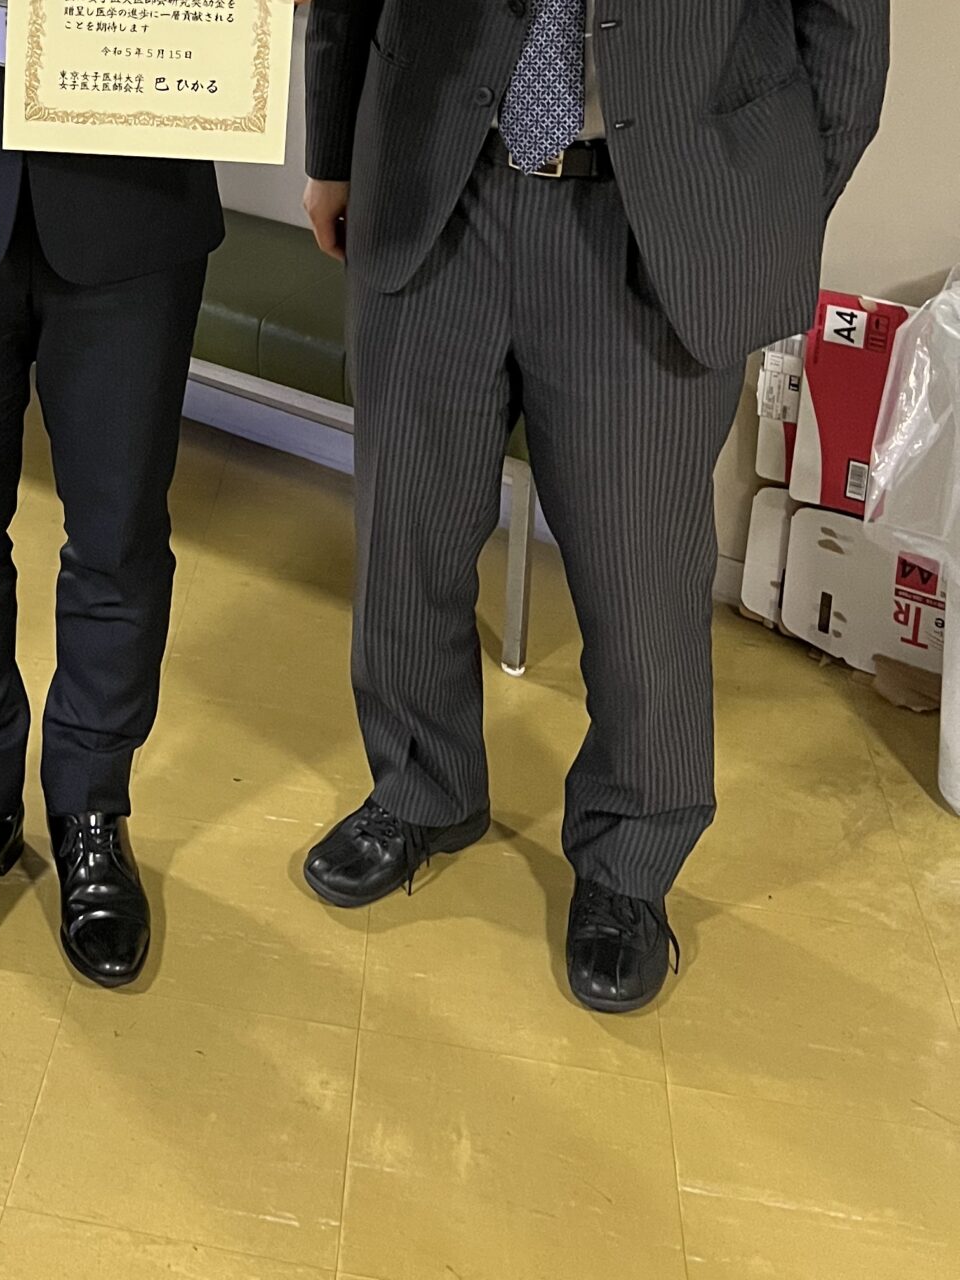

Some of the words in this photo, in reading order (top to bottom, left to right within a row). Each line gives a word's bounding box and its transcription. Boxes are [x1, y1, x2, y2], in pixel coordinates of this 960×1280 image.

[64, 5, 235, 23] 贈呈し医学の進歩に一層貢献される
[64, 20, 150, 33] ことを期待します
[58, 81, 145, 94] 女子医大医師会長
[154, 76, 170, 92] 巴
[176, 78, 219, 94] ひかる
[59, 70, 145, 83] 東京女子医科大学
[833, 310, 858, 344] A4
